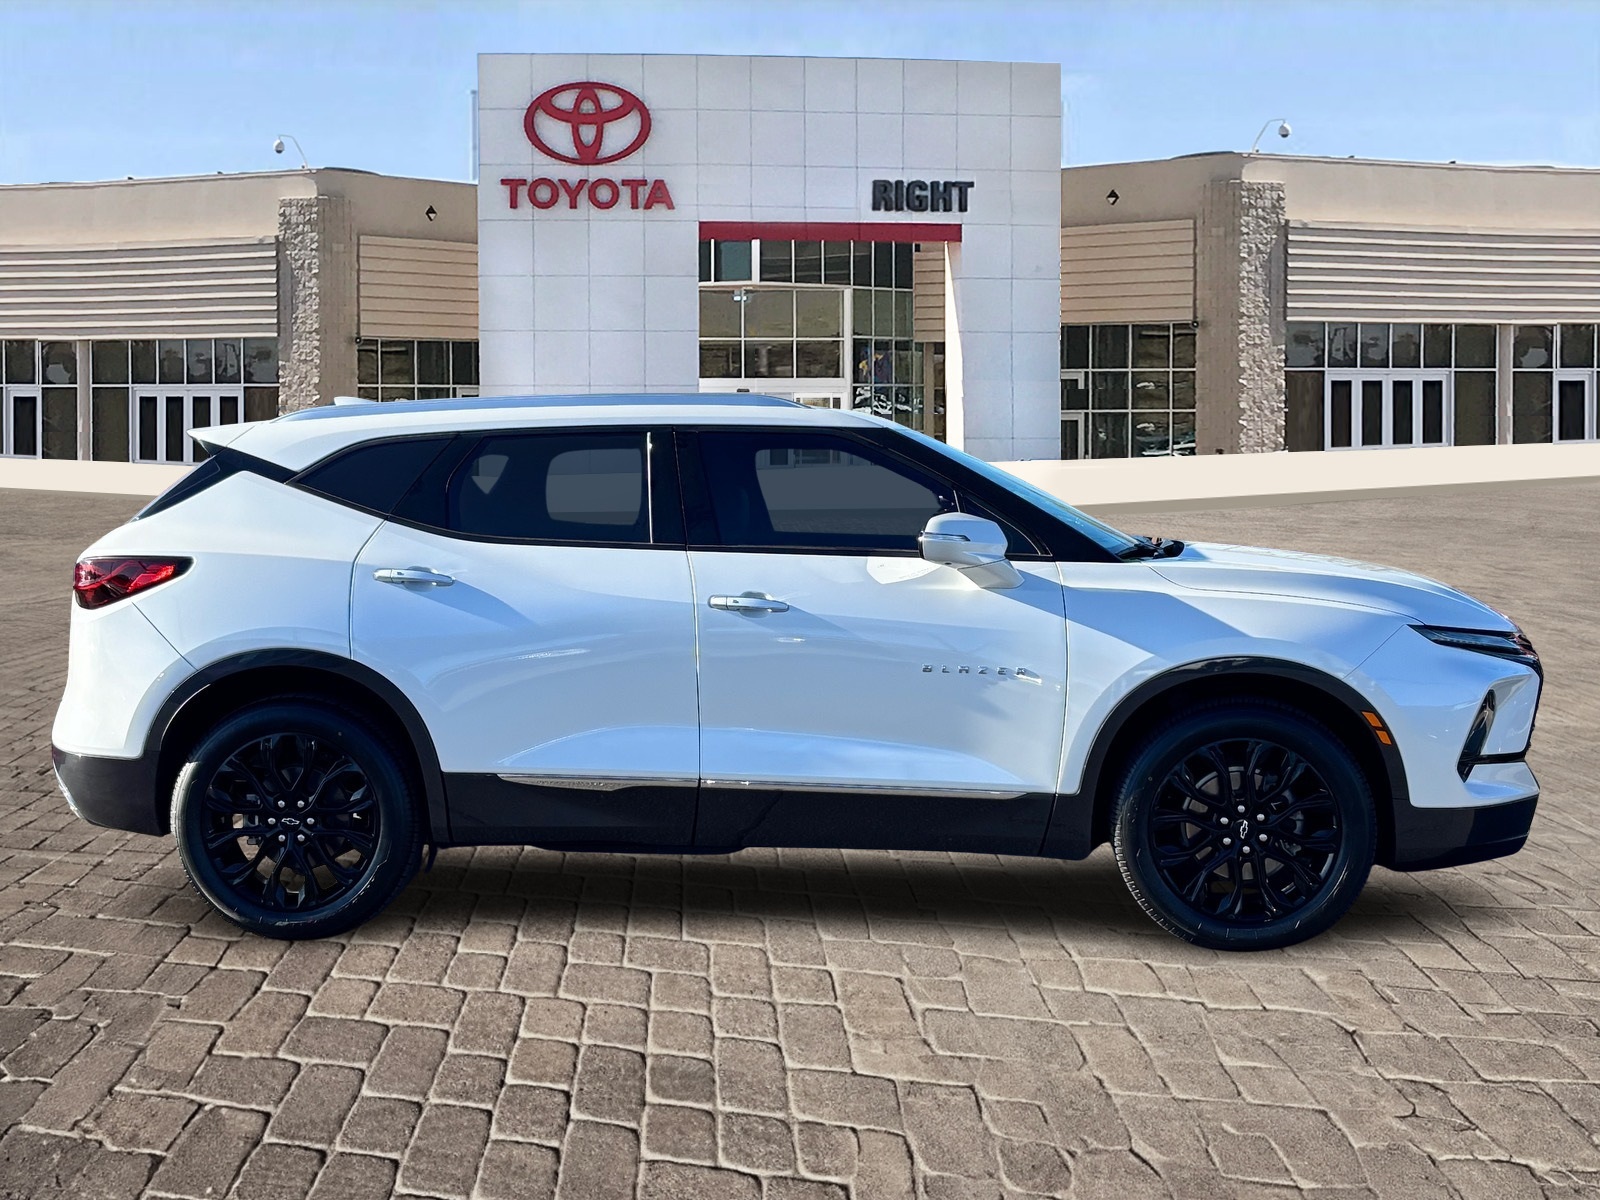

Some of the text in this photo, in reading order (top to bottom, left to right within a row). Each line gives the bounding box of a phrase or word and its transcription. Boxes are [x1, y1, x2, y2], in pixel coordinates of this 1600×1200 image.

[500, 178, 676, 210] TOYOTA
[871, 179, 975, 213] RIGHT
[921, 663, 1026, 676] BLAZER
